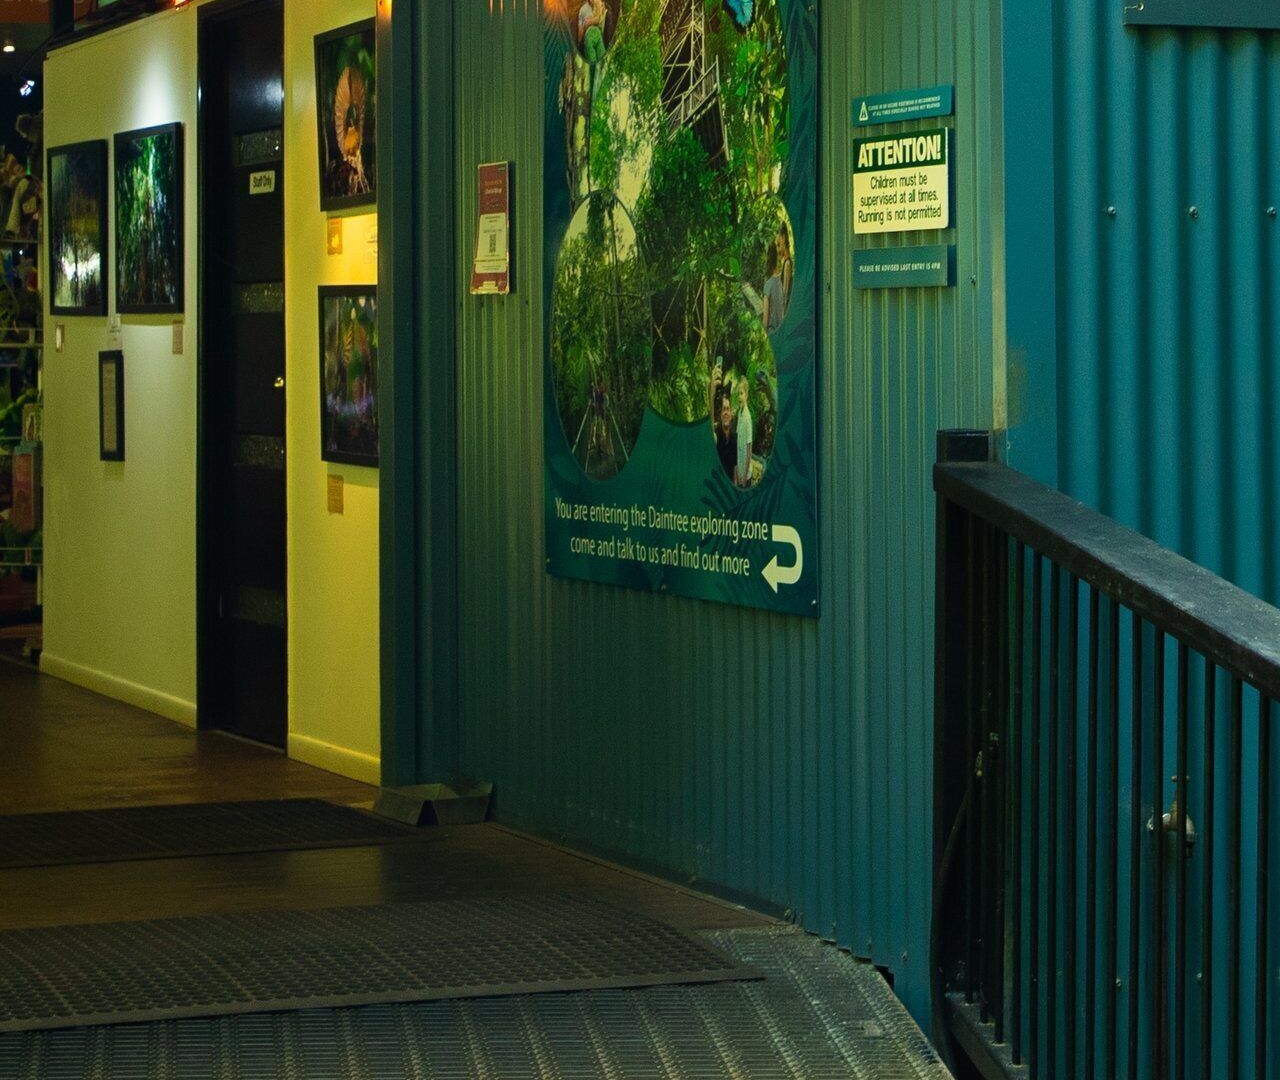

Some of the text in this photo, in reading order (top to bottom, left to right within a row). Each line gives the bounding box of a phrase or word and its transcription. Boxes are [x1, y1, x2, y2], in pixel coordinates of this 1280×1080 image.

[857, 134, 942, 168] ATTENTION!
[870, 172, 928, 190] Children must be
[860, 187, 939, 209] supervised at all times.
[858, 204, 942, 225] Running is not permitted
[555, 497, 769, 544] You are entering the Daintree exploring zone
[570, 536, 751, 576] come and talk to us and find out more
